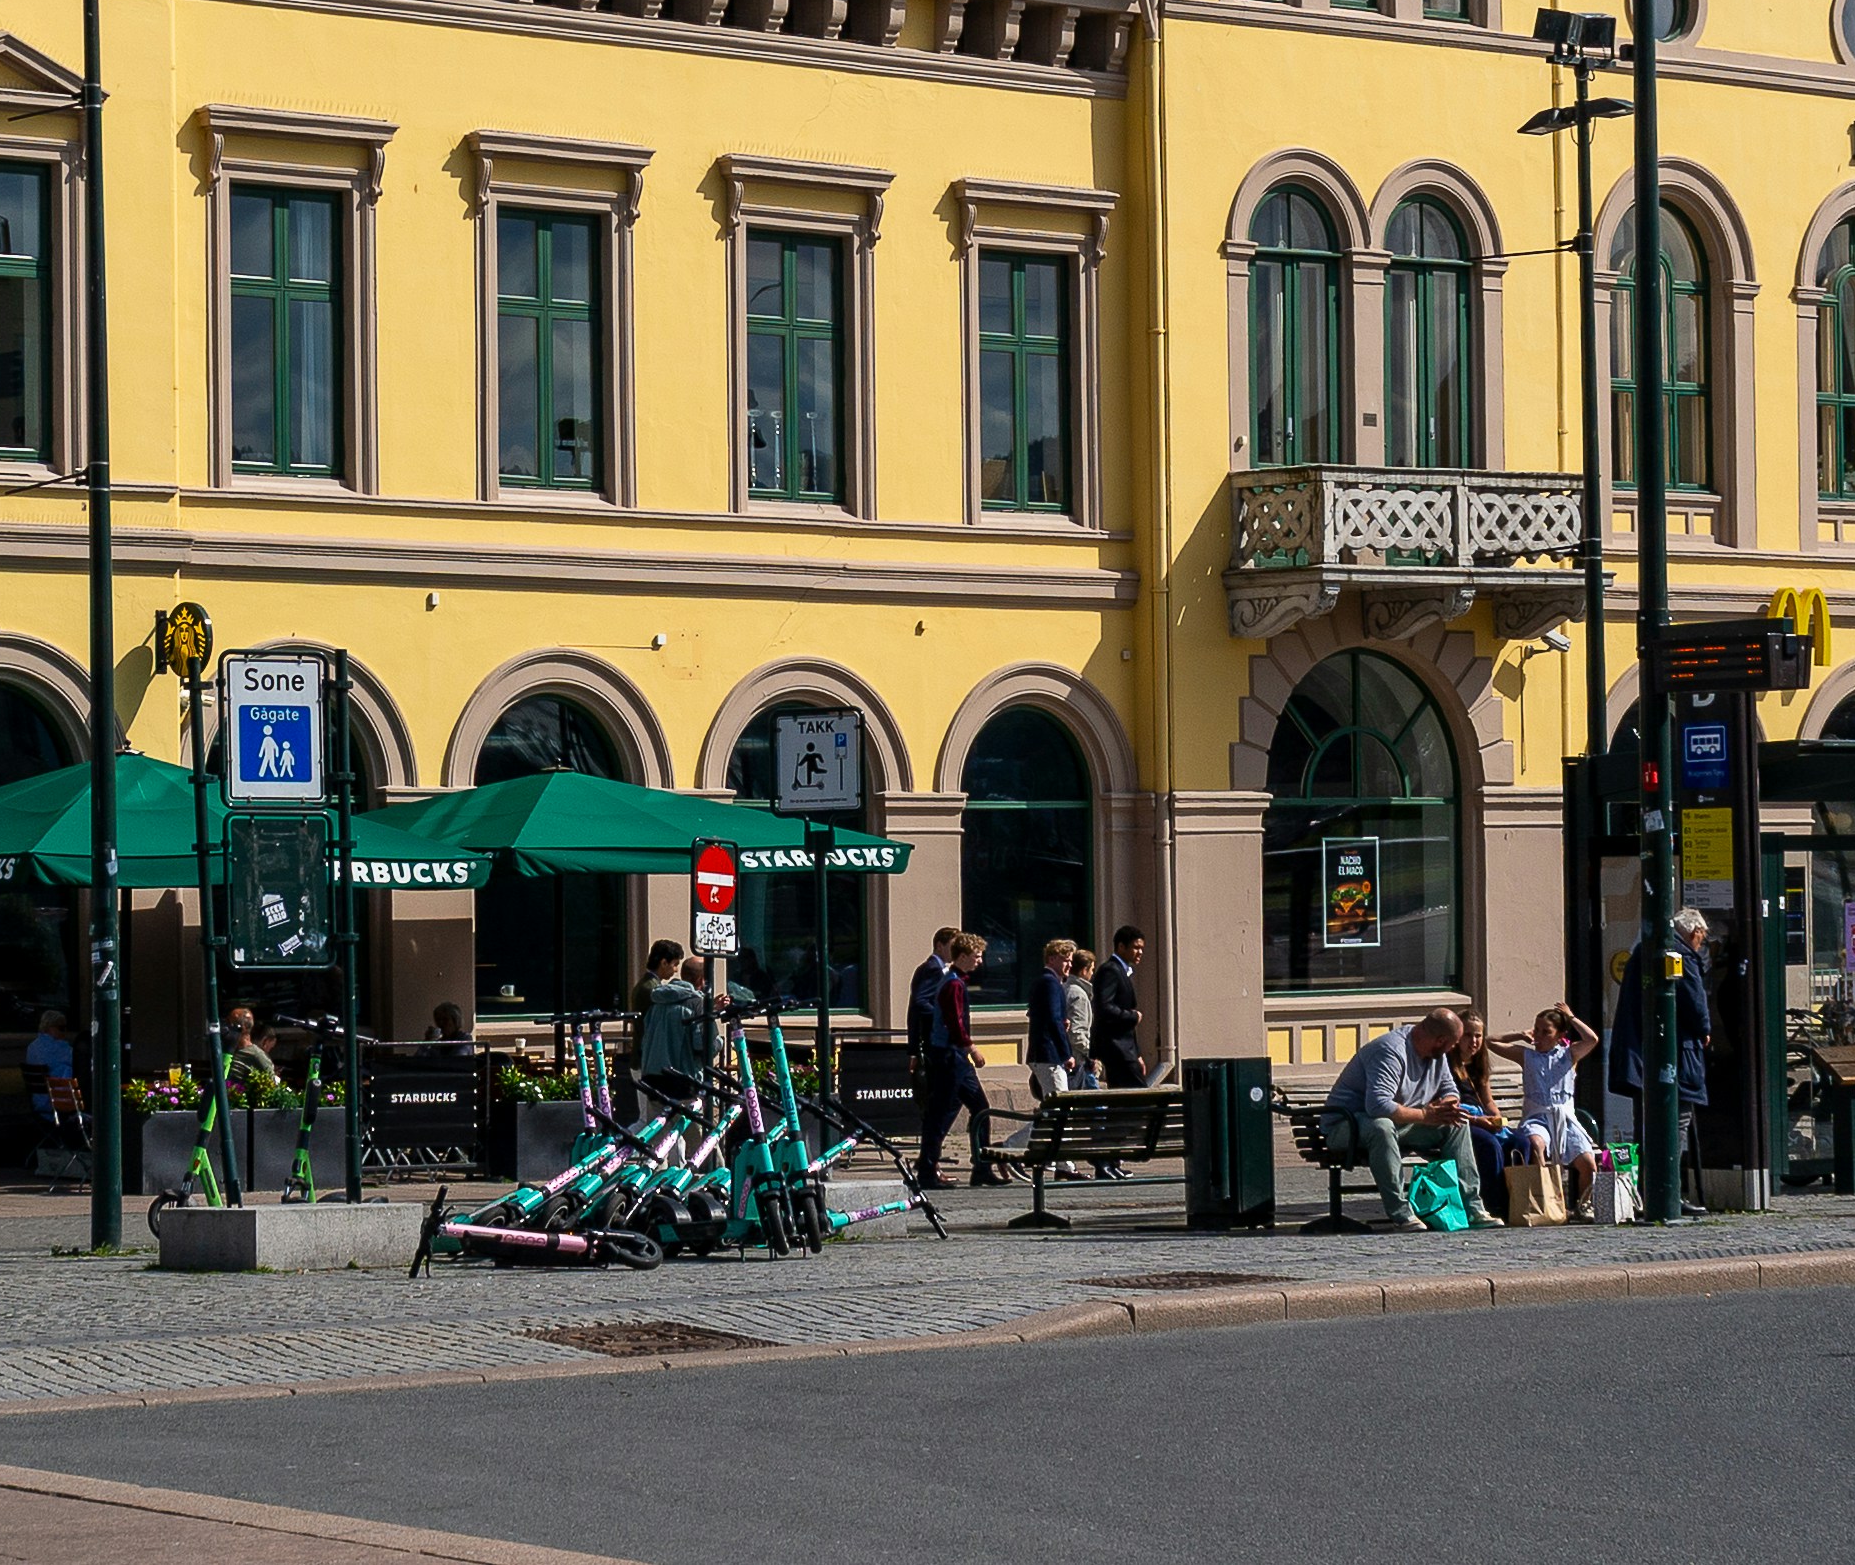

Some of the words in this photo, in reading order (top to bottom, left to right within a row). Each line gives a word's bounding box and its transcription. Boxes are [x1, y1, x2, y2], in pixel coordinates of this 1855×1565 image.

[244, 668, 305, 692] Sone
[250, 706, 300, 723] Gågate
[797, 720, 835, 734] TAKK
[740, 847, 895, 868] STARUCKS
[331, 860, 469, 884] RBUCKS
[391, 1092, 457, 1103] STARBUCKS
[856, 1088, 914, 1100] STARBUCKS
[746, 1089, 761, 1129] GOGO
